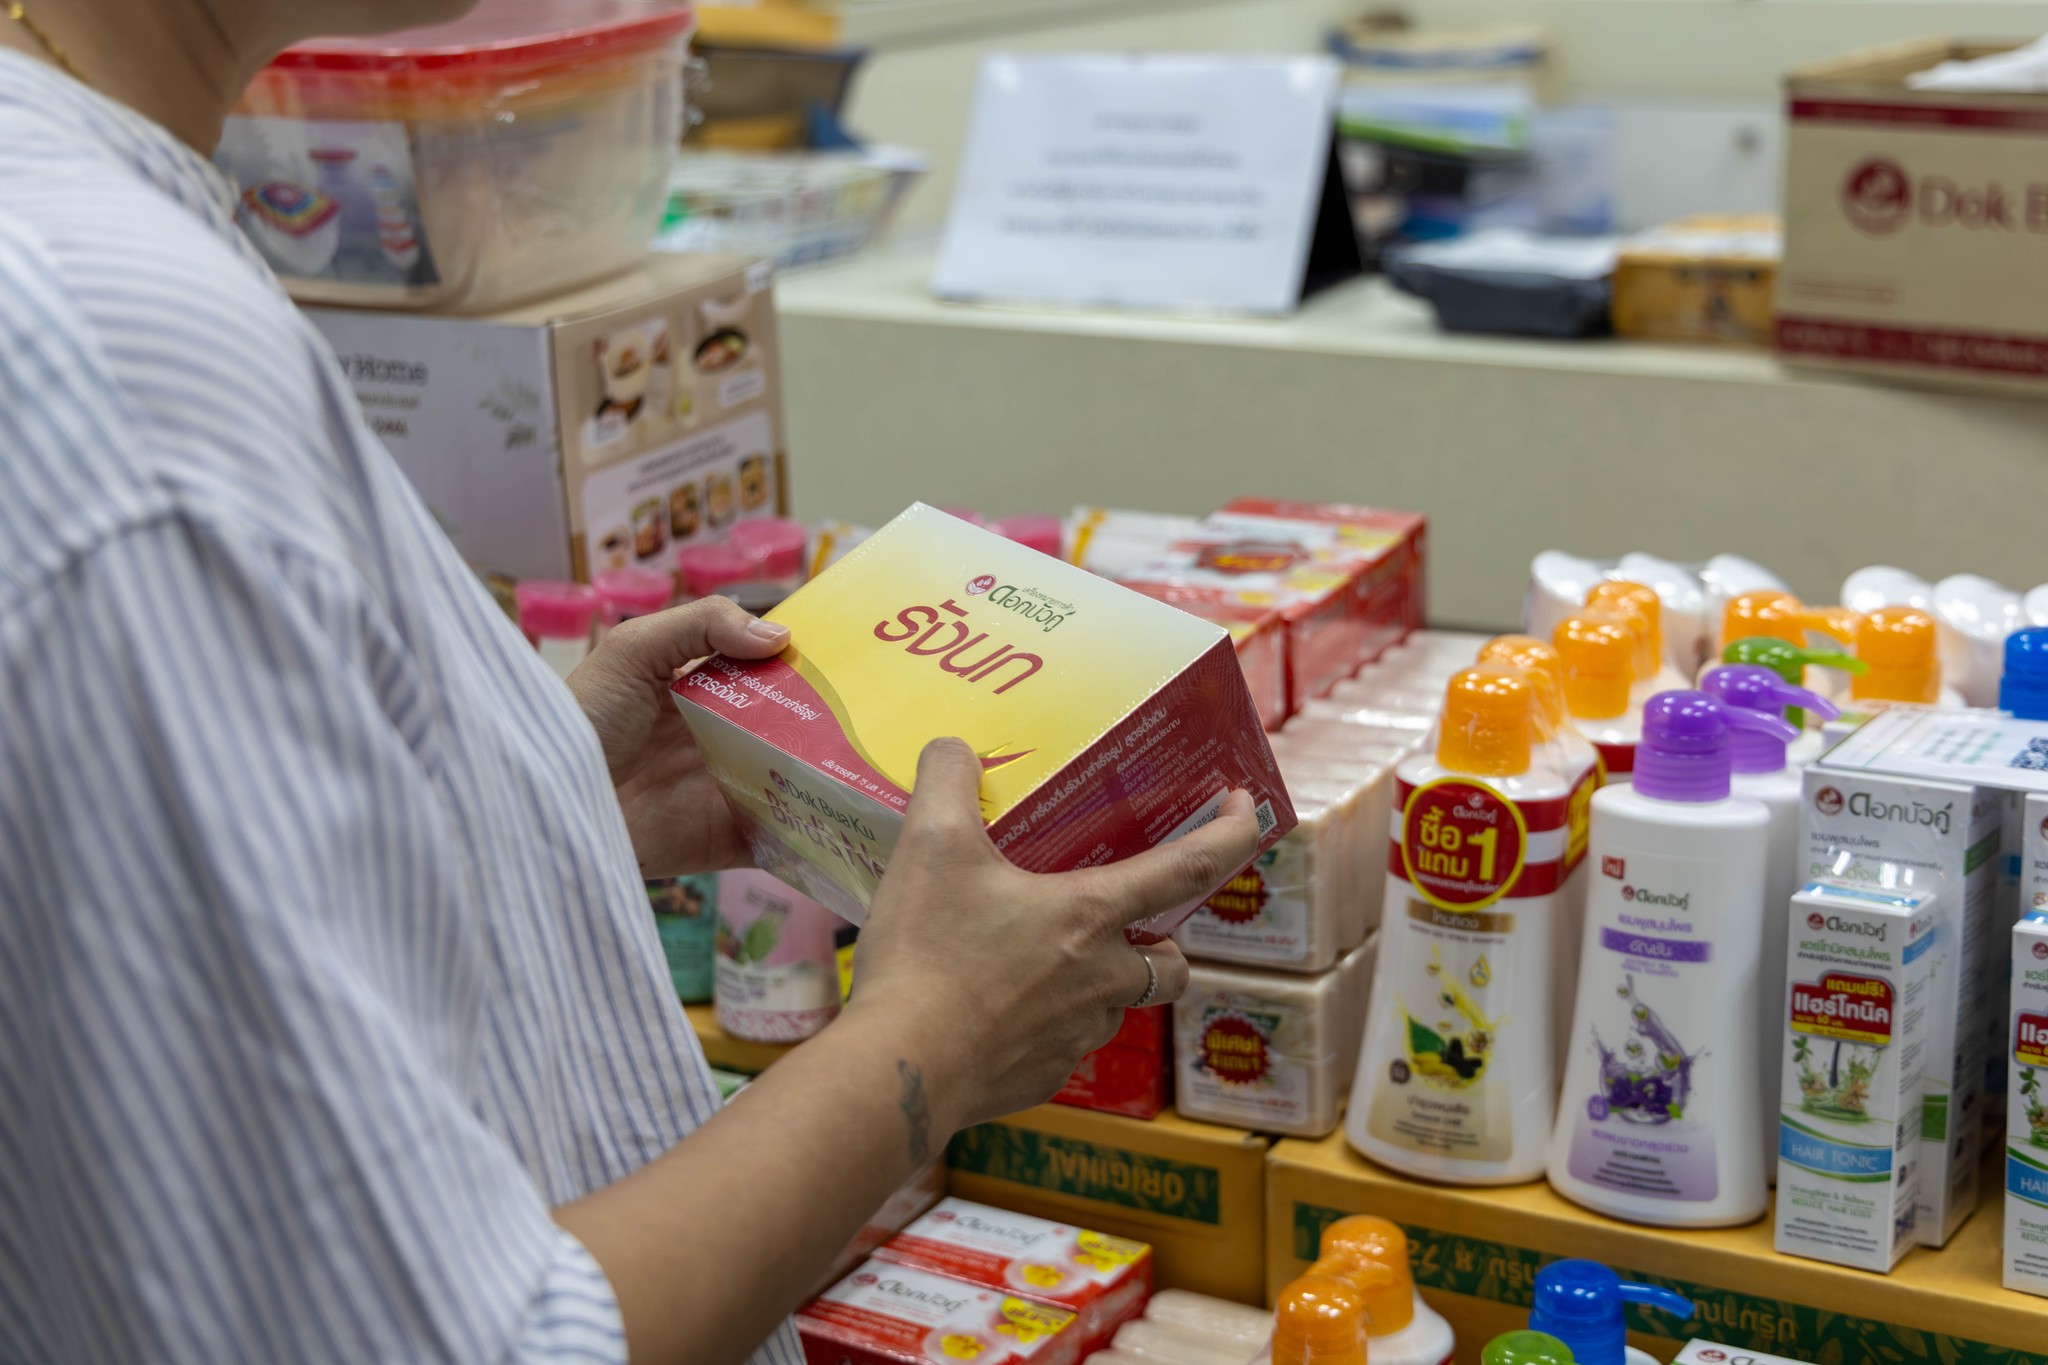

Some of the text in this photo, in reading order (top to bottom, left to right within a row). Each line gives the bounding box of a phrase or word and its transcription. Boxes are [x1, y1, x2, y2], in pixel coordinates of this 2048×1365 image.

[988, 585, 1077, 633] ดอกบัวคู่
[873, 598, 1044, 695] รังนก
[689, 671, 755, 709] สูตรดั้งเดิม
[995, 816, 1031, 850] อกบัวคู่
[1124, 706, 1167, 747] สูตรดั้งเดิม
[1148, 820, 1172, 844] Consumed
[1849, 792, 1954, 835] ดอกบัวคู่
[1420, 805, 1498, 881] ซื้อ 1
[1417, 850, 1469, 879] แถม
[1635, 888, 1690, 911] ดอกบัวคู่
[1826, 916, 1887, 942] ดอกบัวคู่
[1826, 979, 1886, 998] แถมฟรี!
[1050, 1146, 1184, 1206] ORIGINAL
[1792, 1144, 1879, 1171] HAIR TONIC
